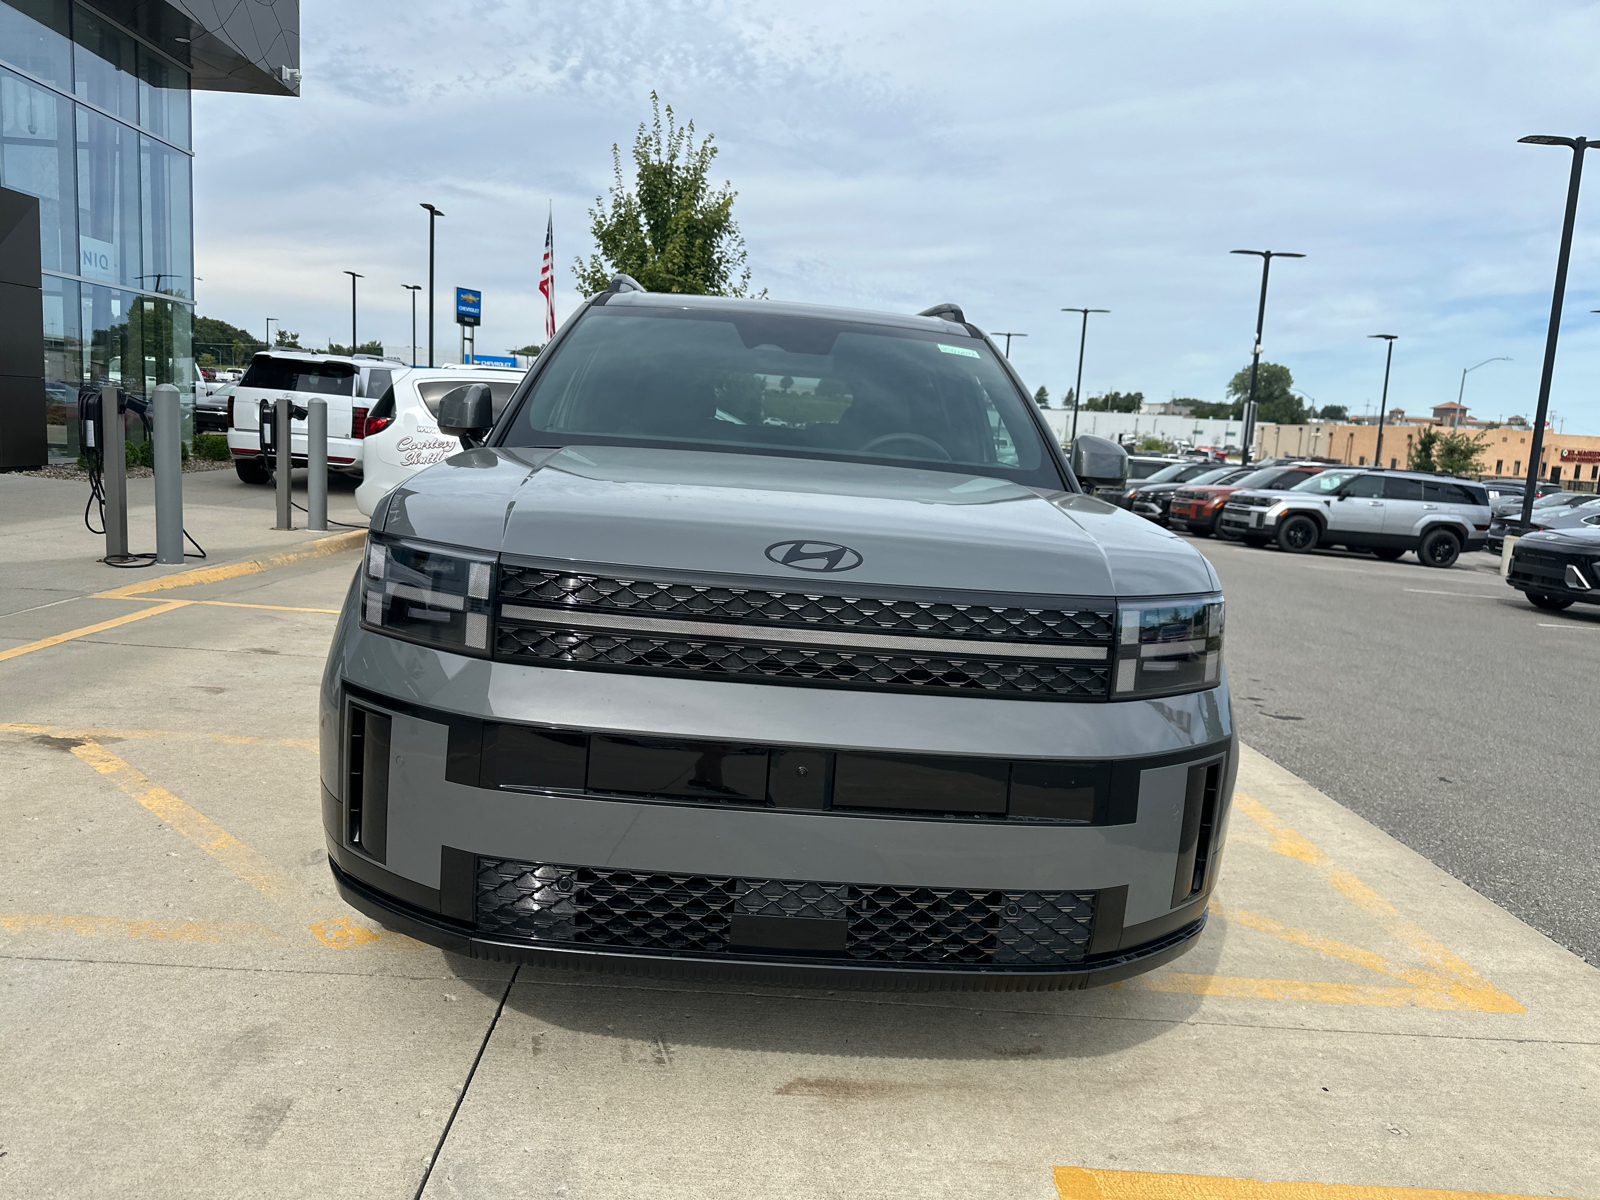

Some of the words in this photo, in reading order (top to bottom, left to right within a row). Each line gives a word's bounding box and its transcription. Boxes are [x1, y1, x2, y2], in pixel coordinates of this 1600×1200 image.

[458, 305, 480, 314] CHEVROLET
[480, 360, 512, 368] CHEVROLET
[396, 436, 457, 452] Courtesy
